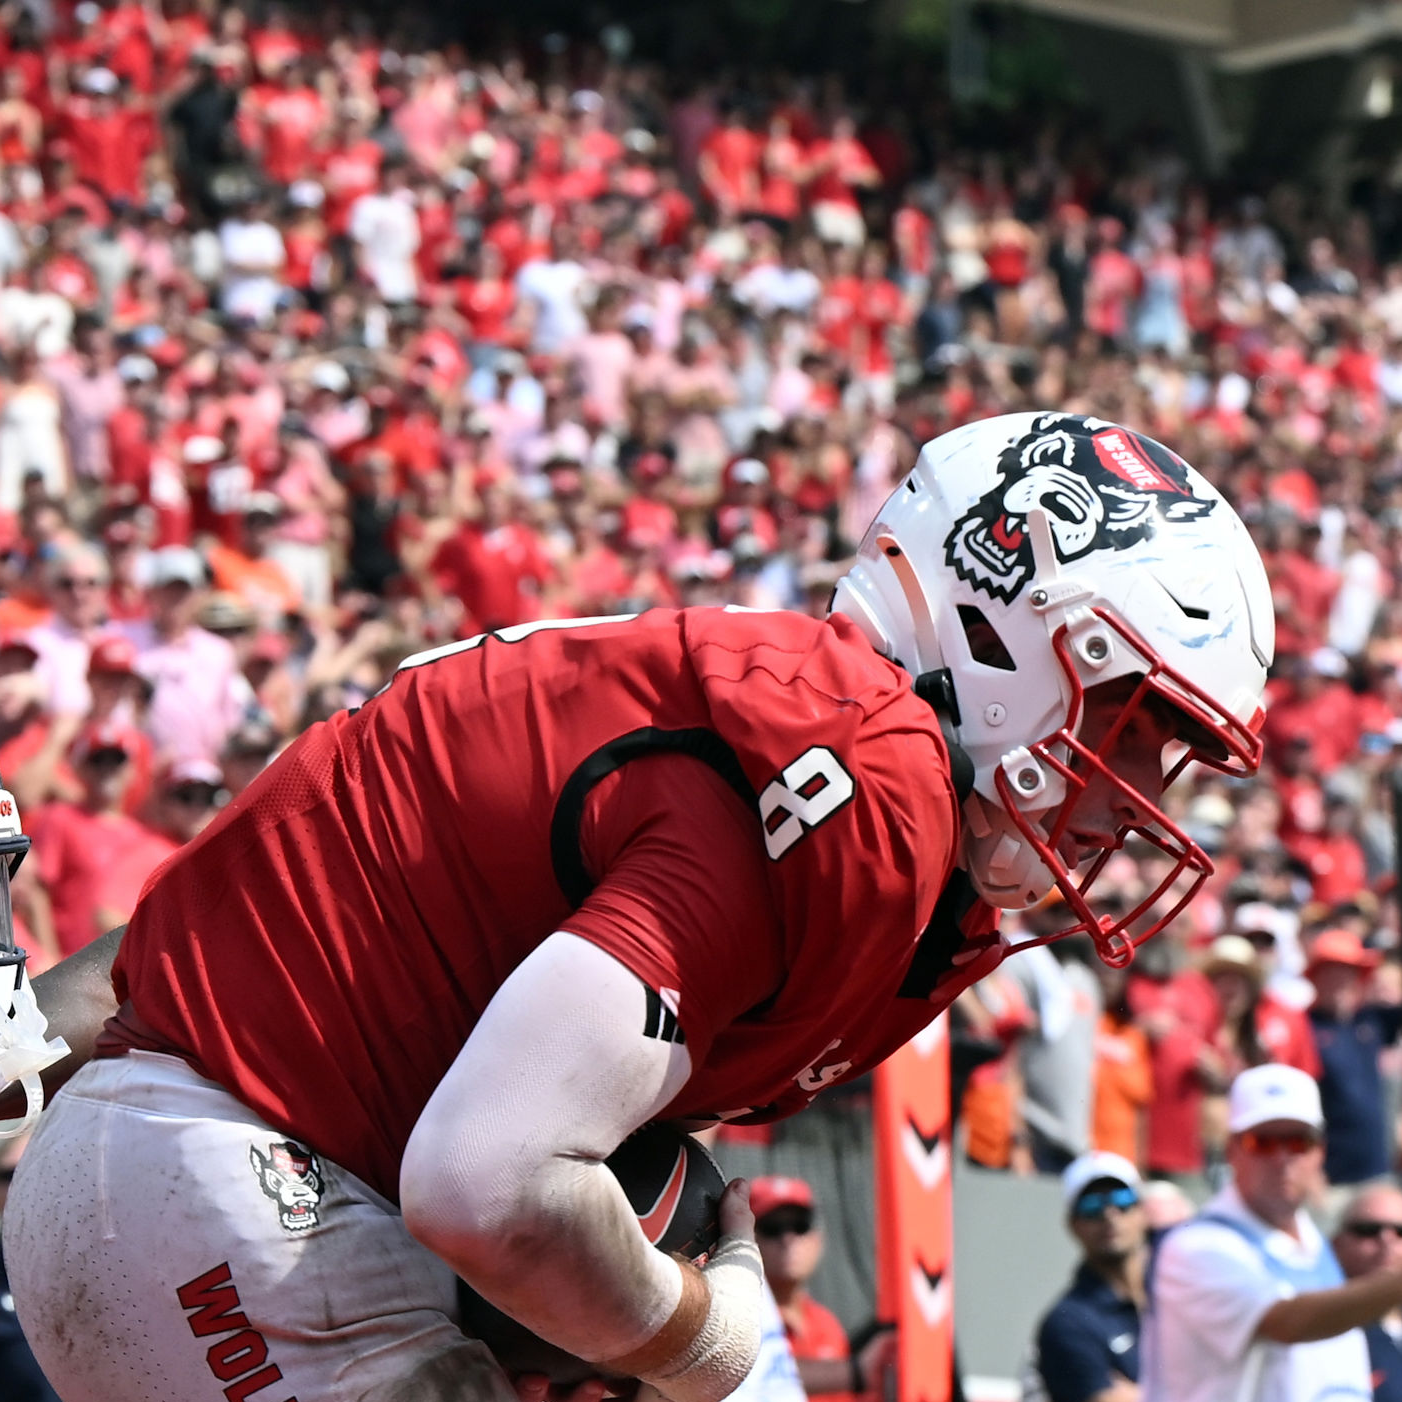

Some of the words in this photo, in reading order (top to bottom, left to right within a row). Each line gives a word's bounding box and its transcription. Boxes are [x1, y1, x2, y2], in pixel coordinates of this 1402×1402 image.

[1097, 433, 1126, 452] NC
[1110, 451, 1161, 488] STATE
[758, 745, 856, 862] 8
